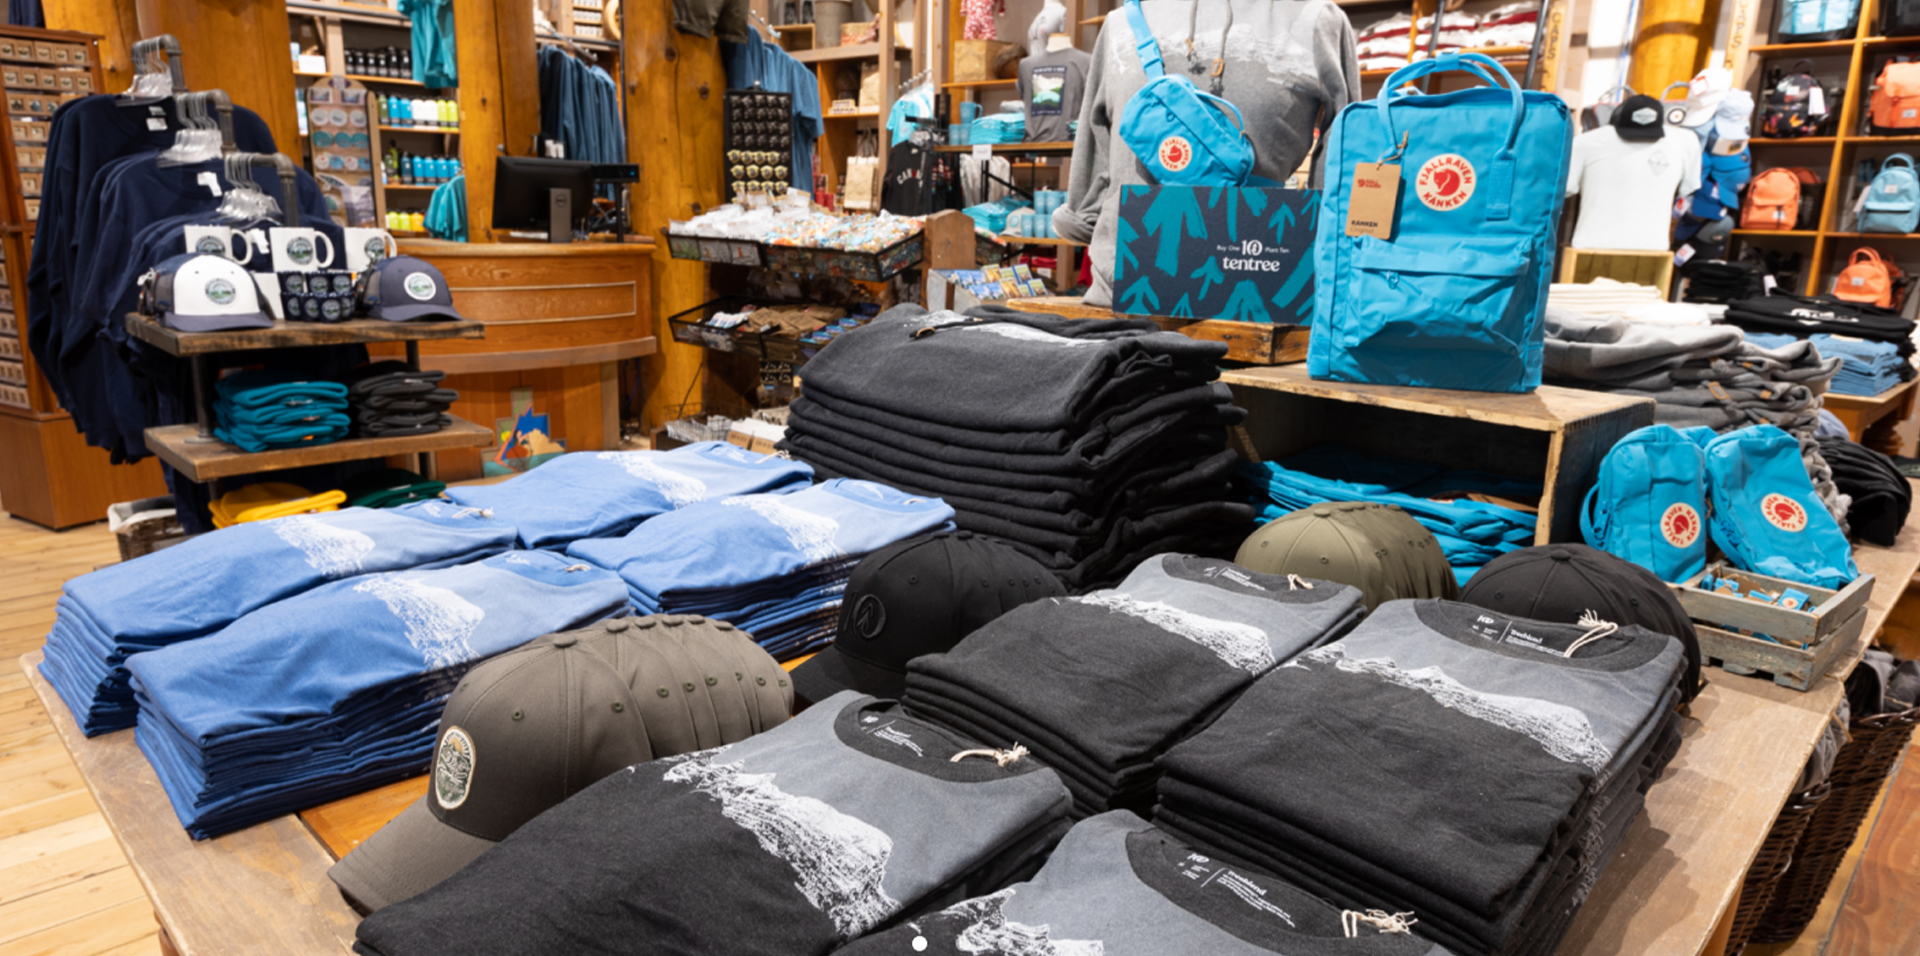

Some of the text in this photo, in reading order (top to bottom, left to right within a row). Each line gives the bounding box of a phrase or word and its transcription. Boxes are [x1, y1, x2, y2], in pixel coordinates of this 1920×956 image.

[1547, 12, 1562, 60] CAPS
[1216, 244, 1227, 252] Buy
[1264, 246, 1279, 254] Plant
[1222, 256, 1280, 272] tentree
